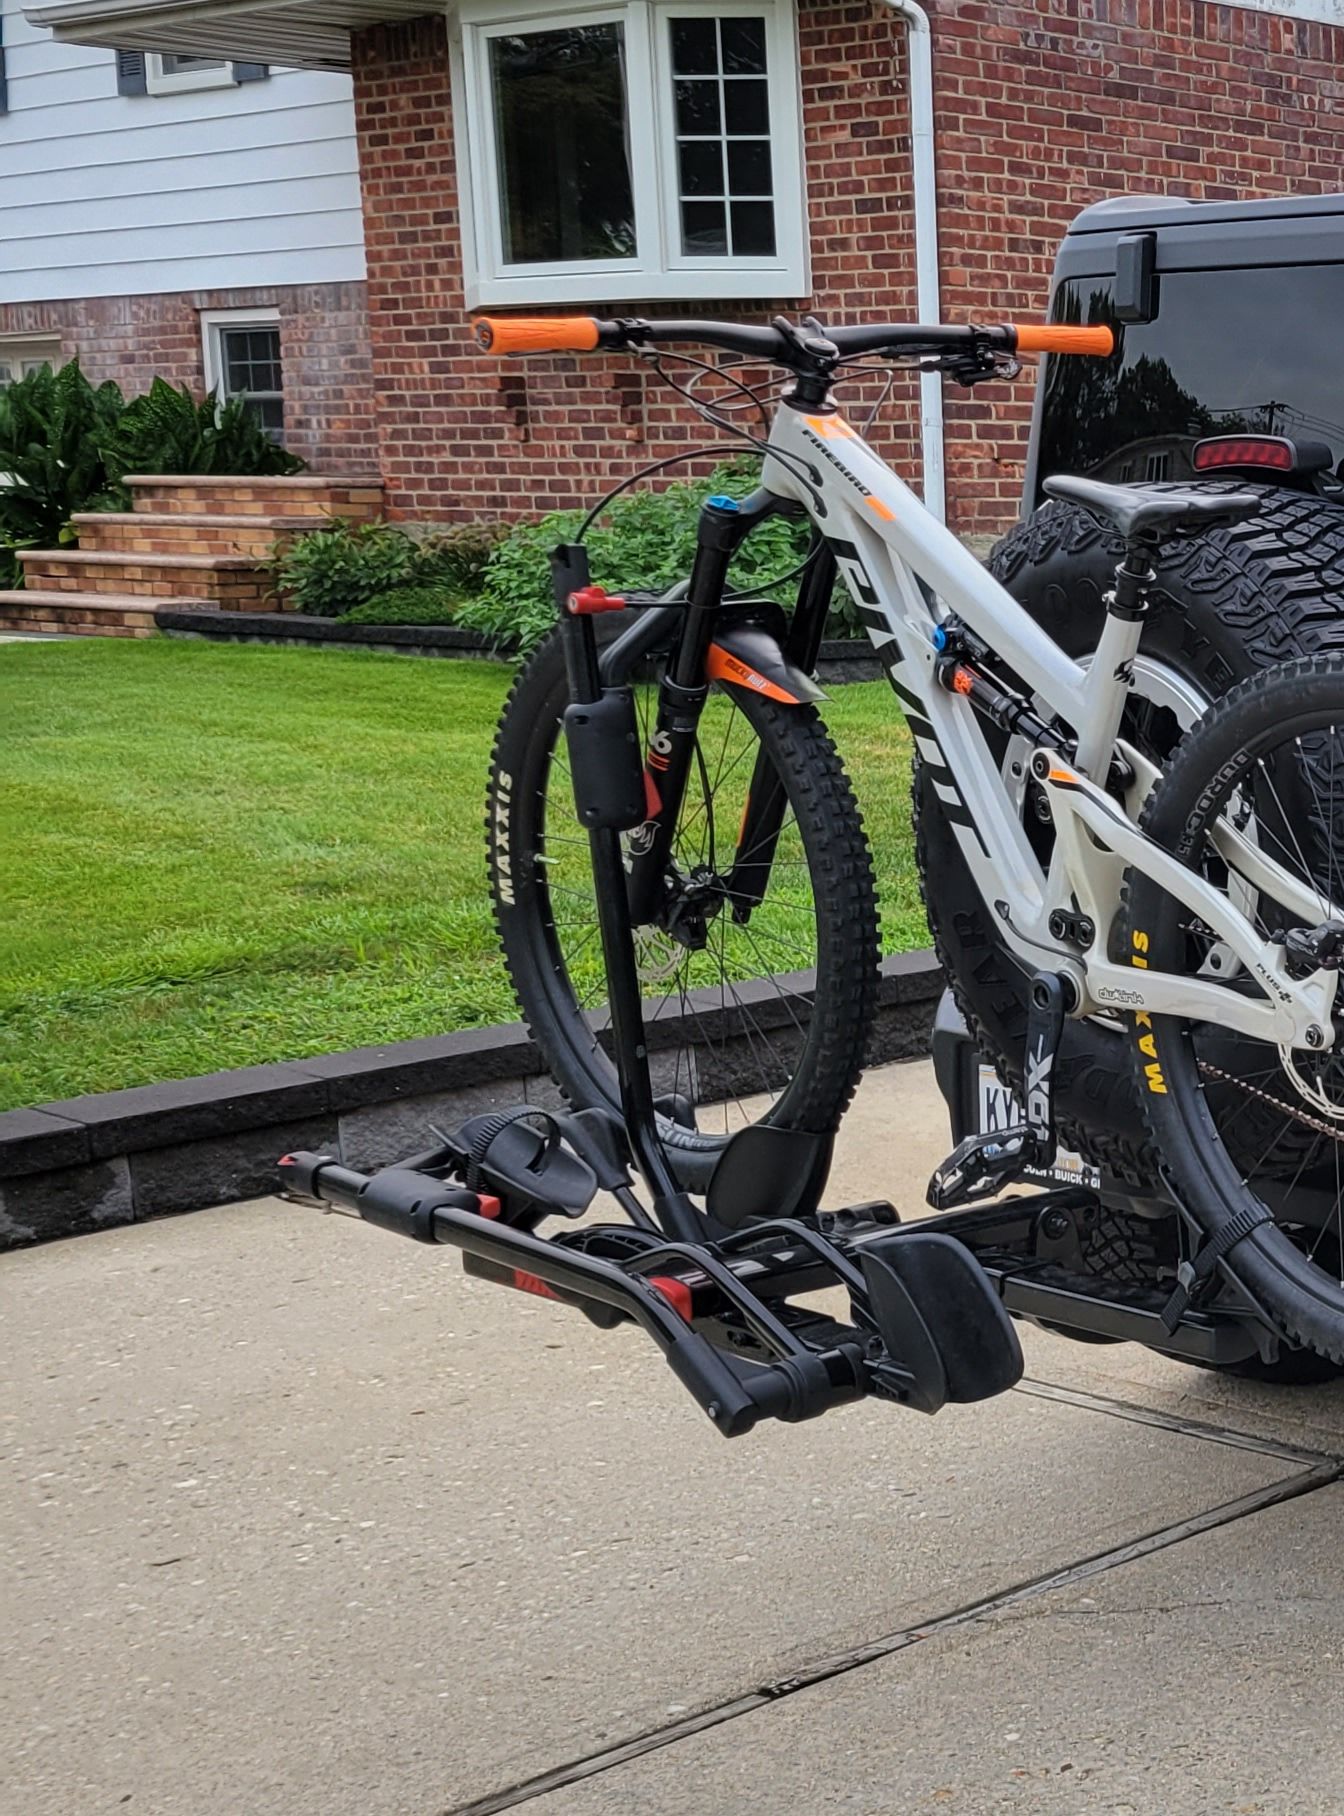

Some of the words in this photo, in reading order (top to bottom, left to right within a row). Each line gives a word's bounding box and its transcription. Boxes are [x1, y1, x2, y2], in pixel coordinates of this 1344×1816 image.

[802, 429, 873, 497] FIREBIRD
[823, 535, 994, 859] PIVOT
[496, 770, 516, 906] MAXXIS
[1131, 929, 1168, 1094] MAXIS
[1054, 1168, 1083, 1186] BUICK
